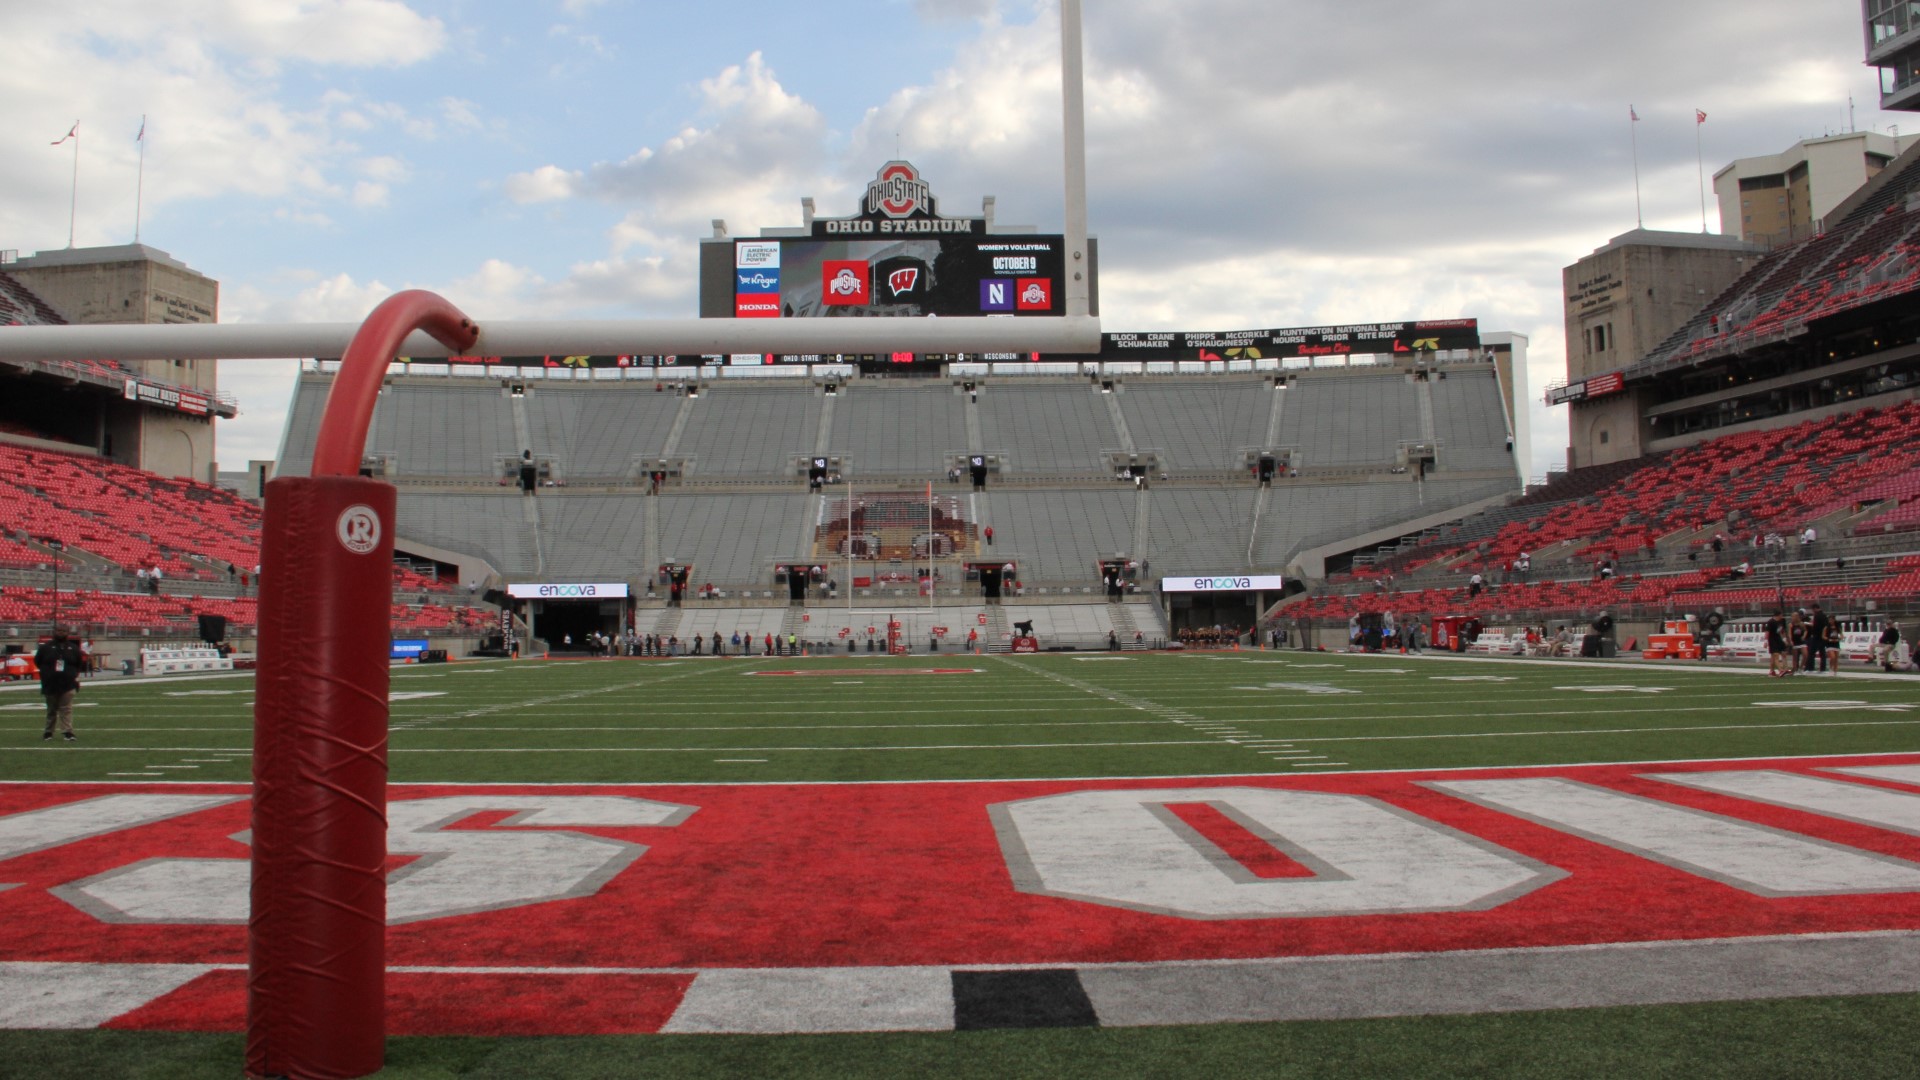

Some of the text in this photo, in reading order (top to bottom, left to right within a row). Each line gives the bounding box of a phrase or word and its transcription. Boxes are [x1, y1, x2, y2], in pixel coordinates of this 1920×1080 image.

[825, 220, 972, 233] OHIO STADIUM
[993, 257, 1036, 270] OCTOBER 9
[751, 273, 778, 288] Kroger
[990, 283, 1004, 304] N
[1226, 330, 1270, 339] McCORKLE
[1280, 323, 1404, 337] HUNTINGTON NATIONAL BANK
[1187, 338, 1254, 348] O'SHAUGHNESSY
[1272, 336, 1306, 344] NOURSE
[1322, 334, 1348, 342] PRIOR
[814, 458, 825, 468] 40
[972, 456, 982, 466] 40
[1194, 577, 1250, 589] encova
[540, 584, 596, 596] encova
